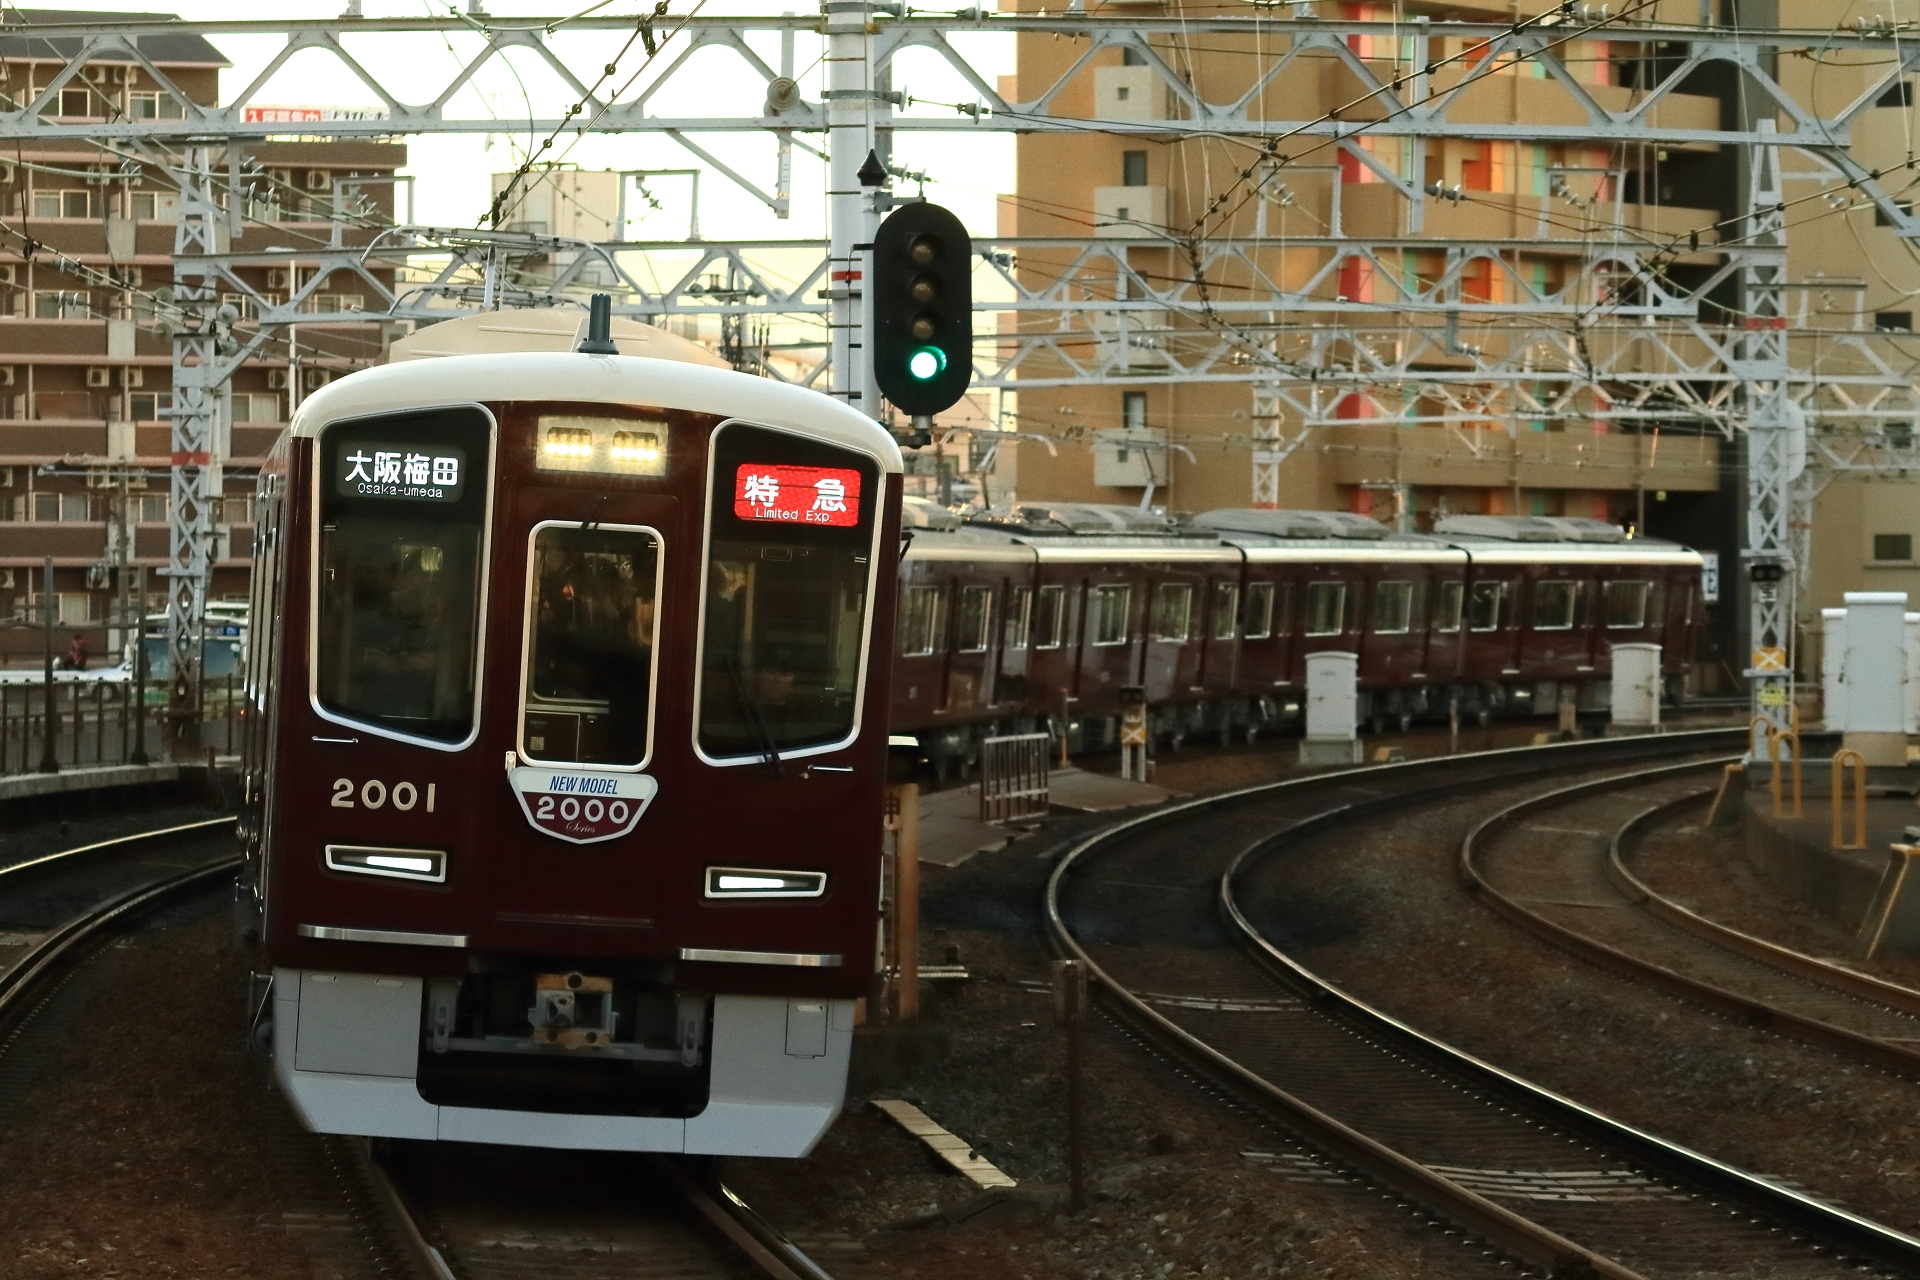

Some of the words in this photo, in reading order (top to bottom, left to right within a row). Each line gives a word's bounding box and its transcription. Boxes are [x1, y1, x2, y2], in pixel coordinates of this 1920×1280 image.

[345, 449, 459, 486] 大阪梅田
[357, 482, 443, 498] Osaka-umeda
[744, 474, 847, 512] 特急
[755, 507, 799, 520] Limited
[806, 510, 832, 523] Exp.
[331, 778, 436, 813] 2001
[550, 776, 578, 792] NEW
[578, 777, 618, 795] MODEL
[536, 796, 629, 824] 2000
[566, 821, 596, 834] Series
